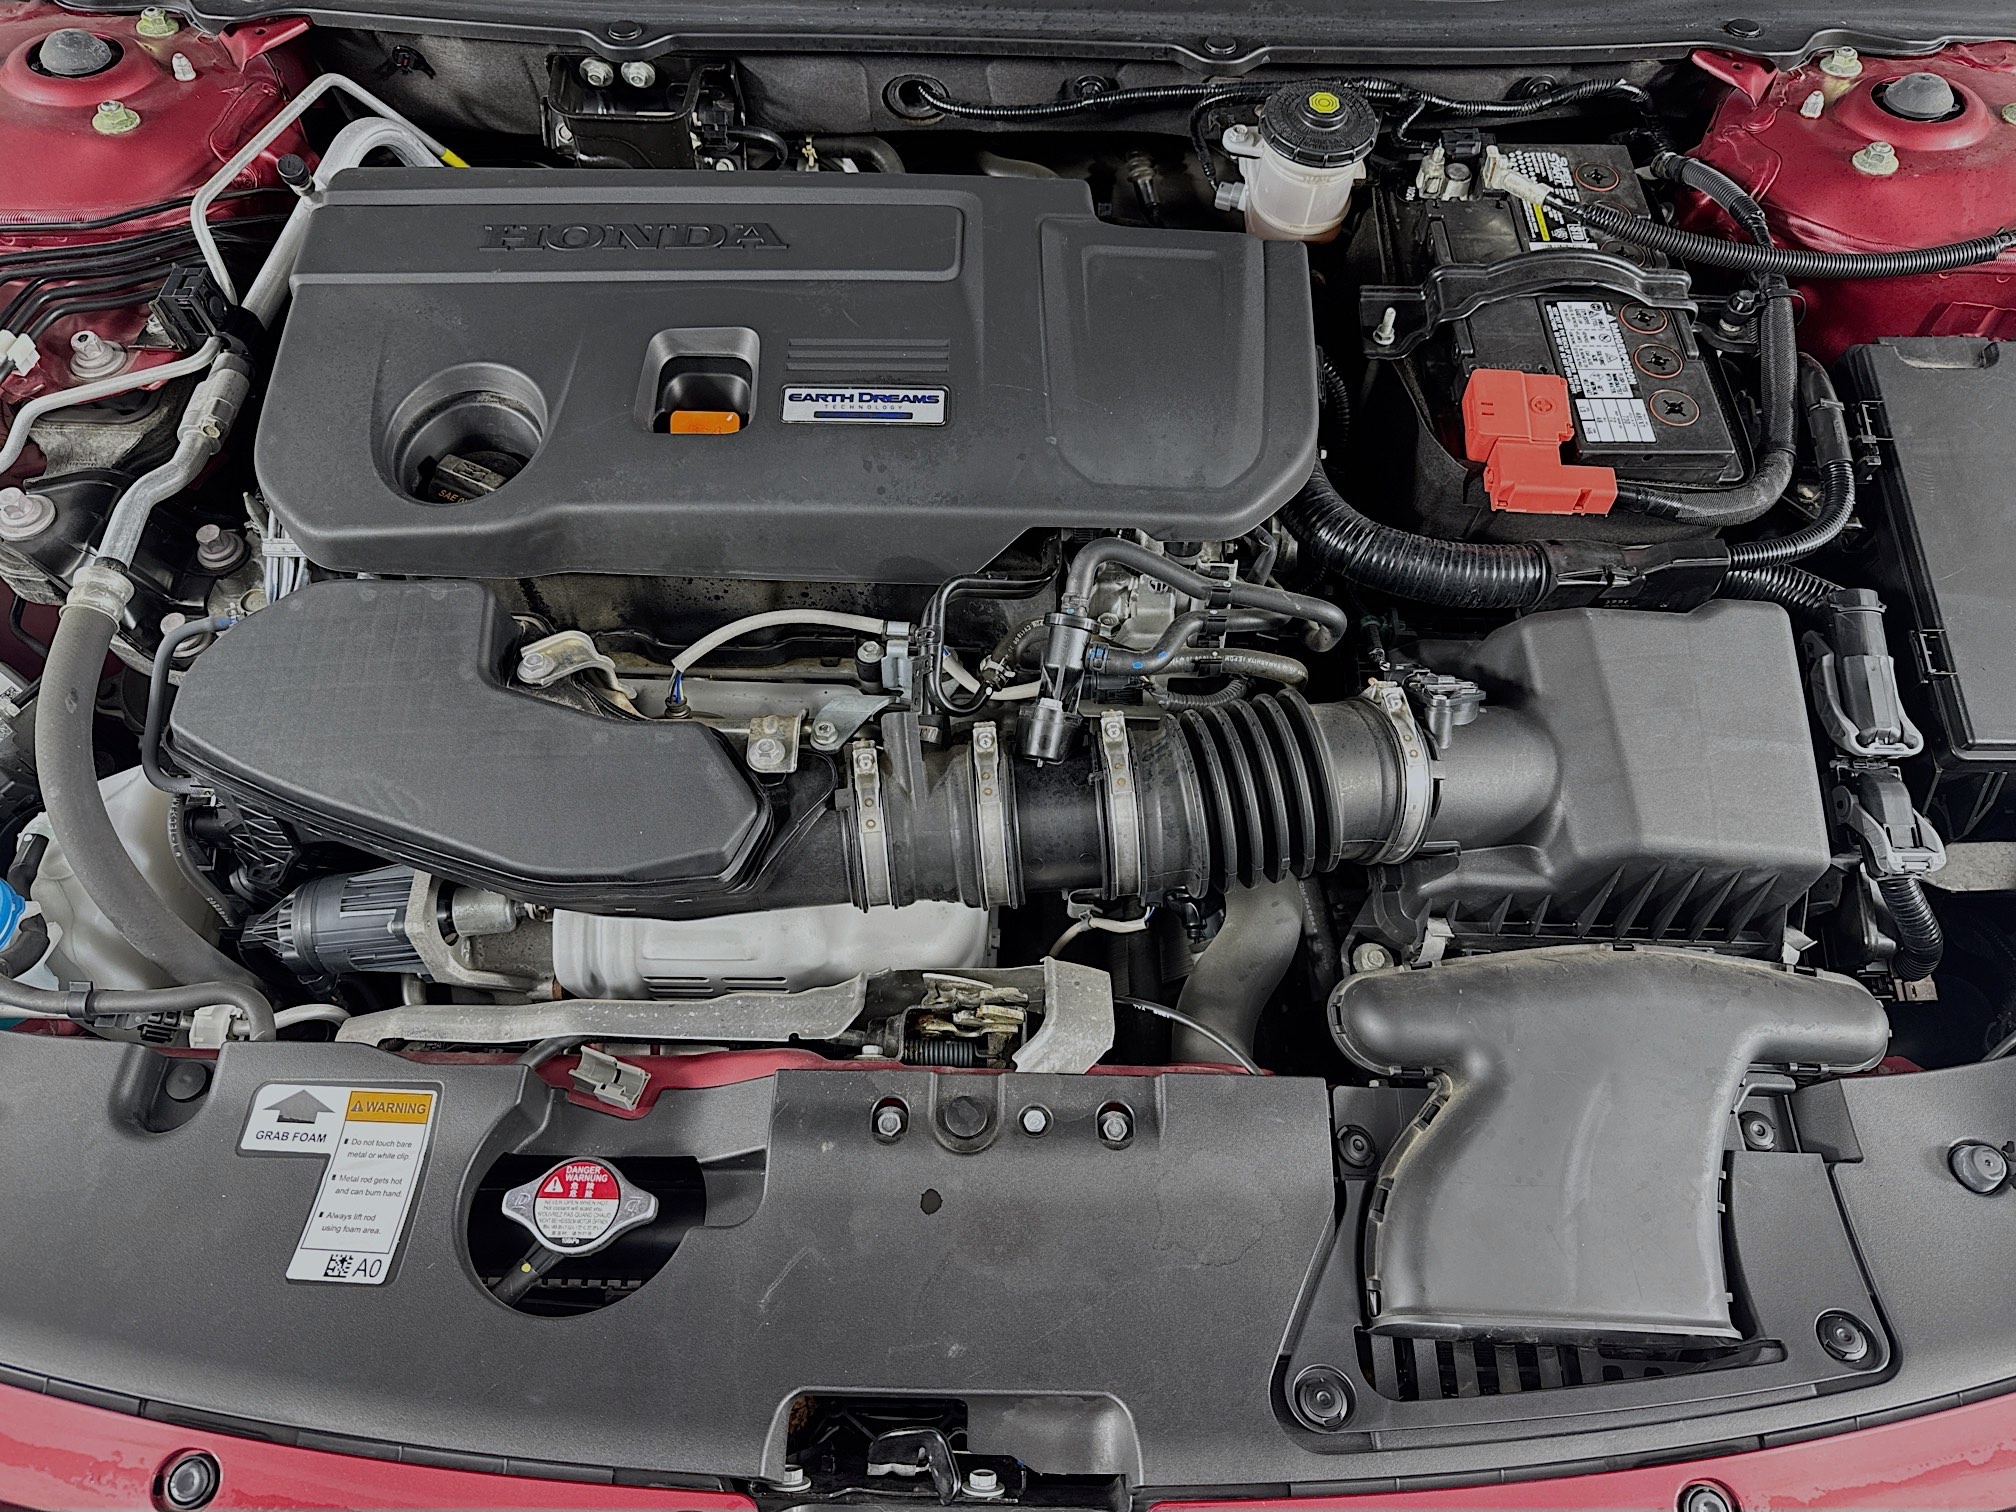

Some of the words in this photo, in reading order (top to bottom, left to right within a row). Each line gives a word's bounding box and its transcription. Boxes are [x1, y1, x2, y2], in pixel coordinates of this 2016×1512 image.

[479, 223, 790, 250] HONDA
[788, 393, 854, 403] EARTH
[858, 392, 940, 404] DREAMS
[438, 489, 459, 503] SAE
[366, 1102, 427, 1114] WARNING
[256, 1130, 290, 1141] GRAB
[292, 1132, 327, 1143] FOAM
[351, 1138, 362, 1146] Do
[376, 1139, 395, 1147] touch
[397, 1140, 412, 1148] bare
[566, 1165, 602, 1174] DANGER
[339, 1174, 359, 1183] Metal
[360, 1176, 373, 1184] rod
[373, 1178, 389, 1186] gets
[390, 1177, 403, 1185] hot
[565, 1173, 608, 1183] WARNUNG
[335, 1187, 350, 1195] and
[364, 1188, 381, 1196] burn
[325, 1211, 352, 1221] Always
[353, 1213, 363, 1221] lift
[363, 1214, 376, 1222] rod
[321, 1224, 341, 1234] using
[343, 1225, 361, 1233] foam
[362, 1227, 381, 1235] area.
[352, 1258, 383, 1279] A0
